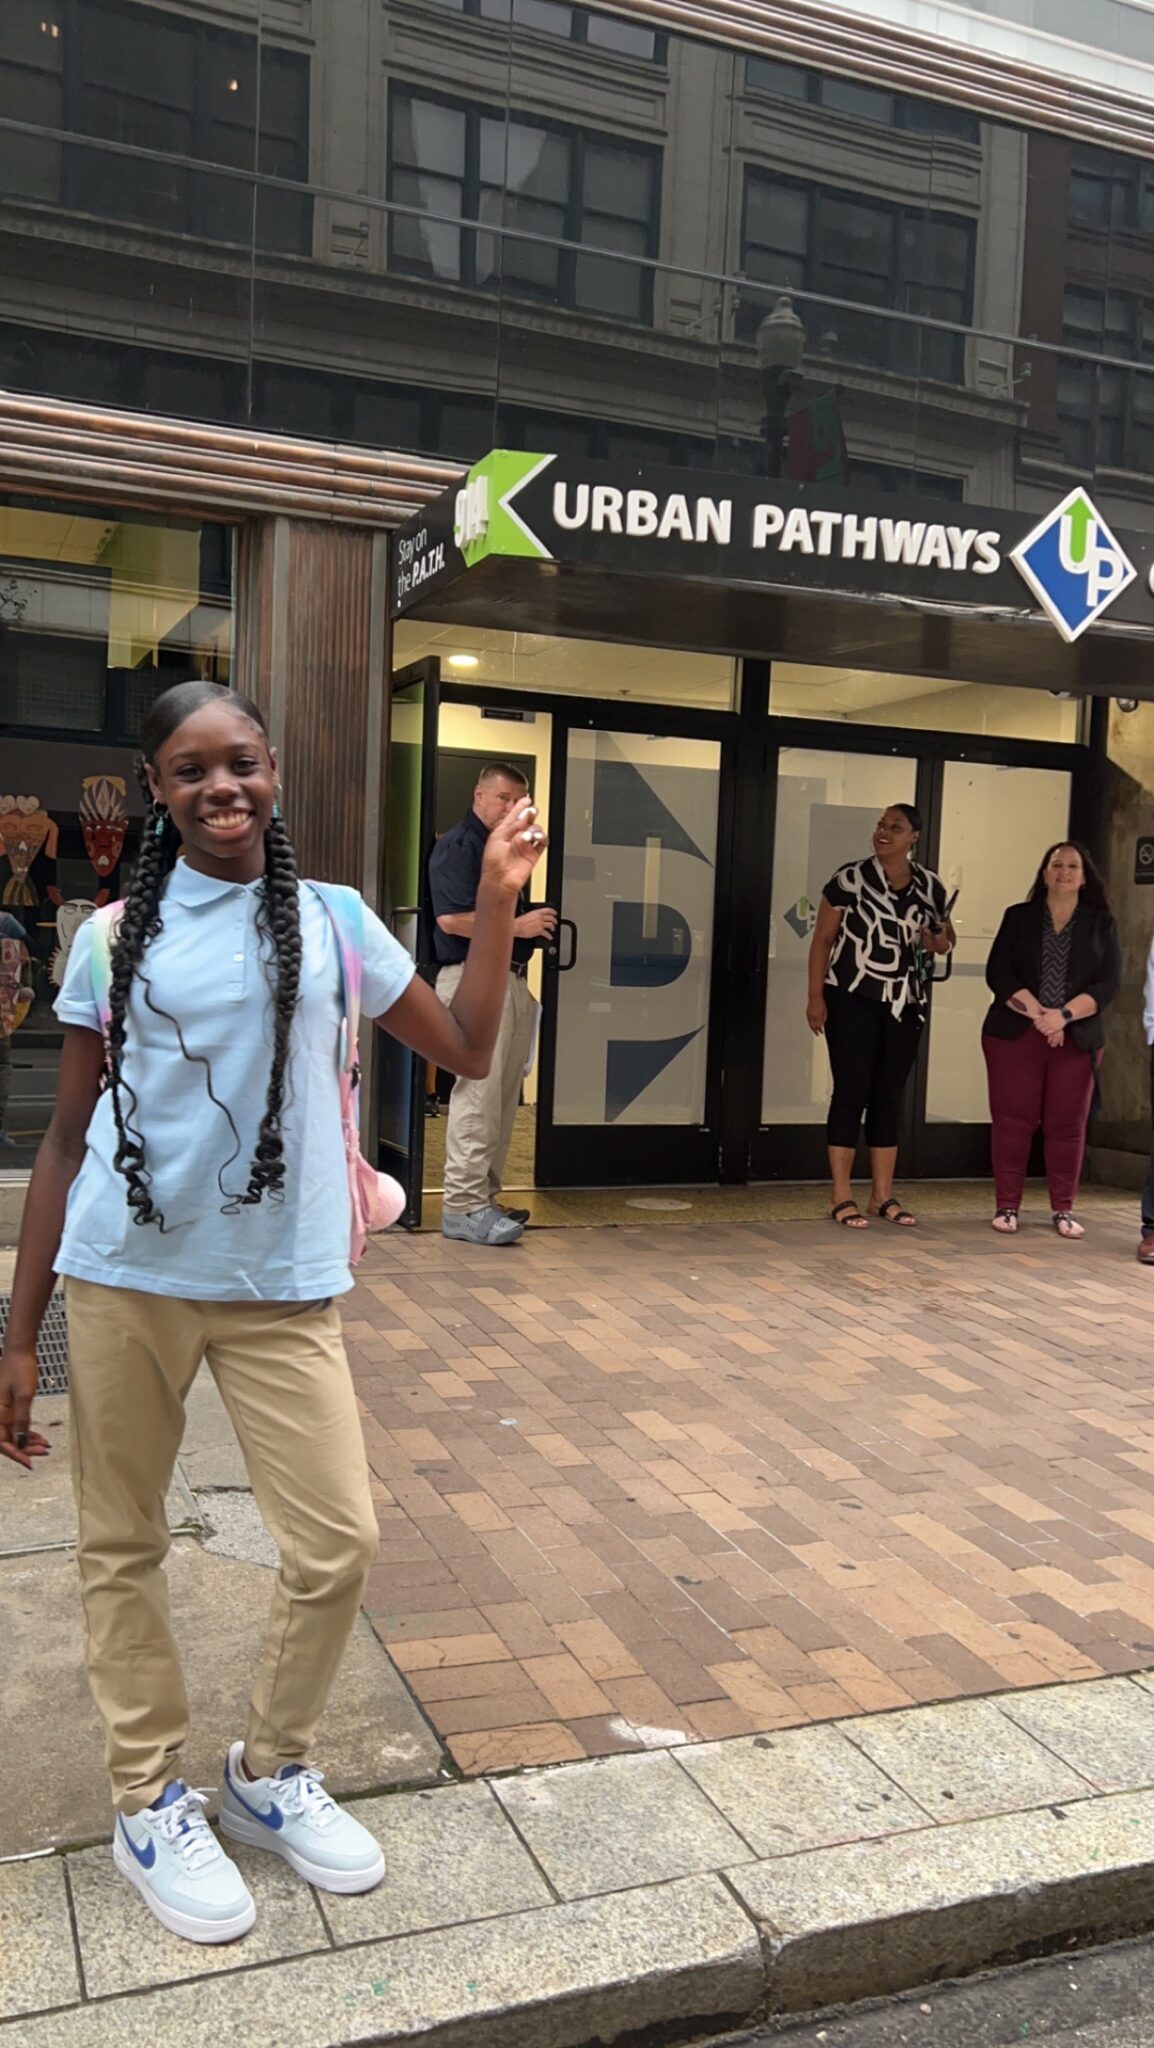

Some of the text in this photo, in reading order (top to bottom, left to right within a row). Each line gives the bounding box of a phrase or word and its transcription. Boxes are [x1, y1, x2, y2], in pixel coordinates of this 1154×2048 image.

[398, 528, 428, 565] Stay on
[553, 481, 1001, 575] URBAN PATHWAYS
[1059, 505, 1124, 607] UP
[397, 542, 445, 597] the P.A.T.H.
